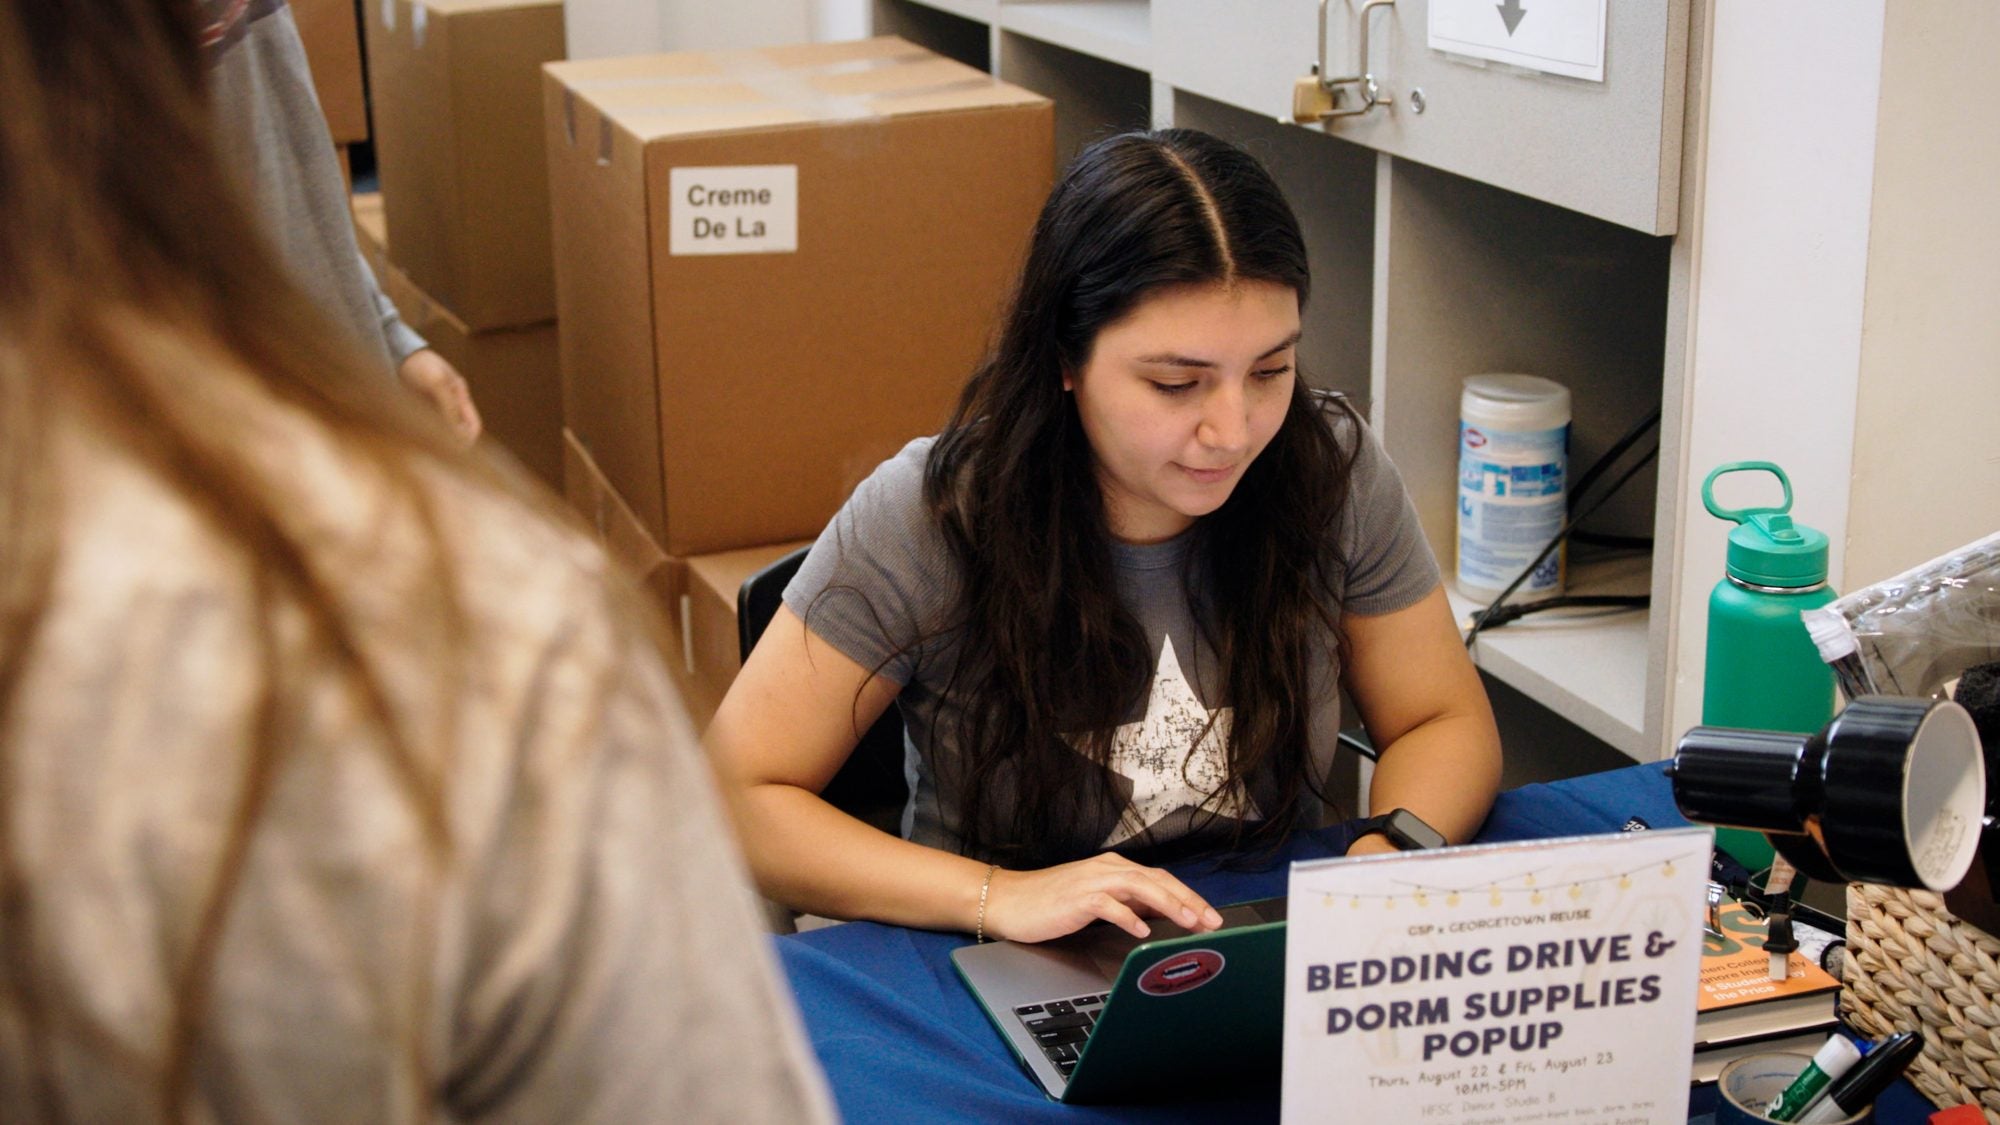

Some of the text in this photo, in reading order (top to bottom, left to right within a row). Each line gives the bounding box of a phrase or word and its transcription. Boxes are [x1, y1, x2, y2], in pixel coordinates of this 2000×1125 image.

[687, 184, 771, 206] Creme
[693, 216, 766, 239] De La
[1408, 925, 1434, 936] CSP
[1449, 914, 1546, 933] GEORGETOWN
[1550, 908, 1592, 922] REUSE
[1307, 931, 1676, 992] BEDDING DRIVE &
[1716, 976, 1772, 990] Student
[1791, 969, 1806, 978] ay
[1327, 974, 1661, 1035] DORM SUPPLIES
[1713, 985, 1775, 1001] the Price
[1422, 1022, 1563, 1061] POPUP
[1418, 1070, 1461, 1087] August
[1471, 1065, 1488, 1078] 22
[1545, 1056, 1587, 1074] August
[1597, 1051, 1614, 1065] 23
[1455, 1079, 1526, 1096] 10AM-5PM
